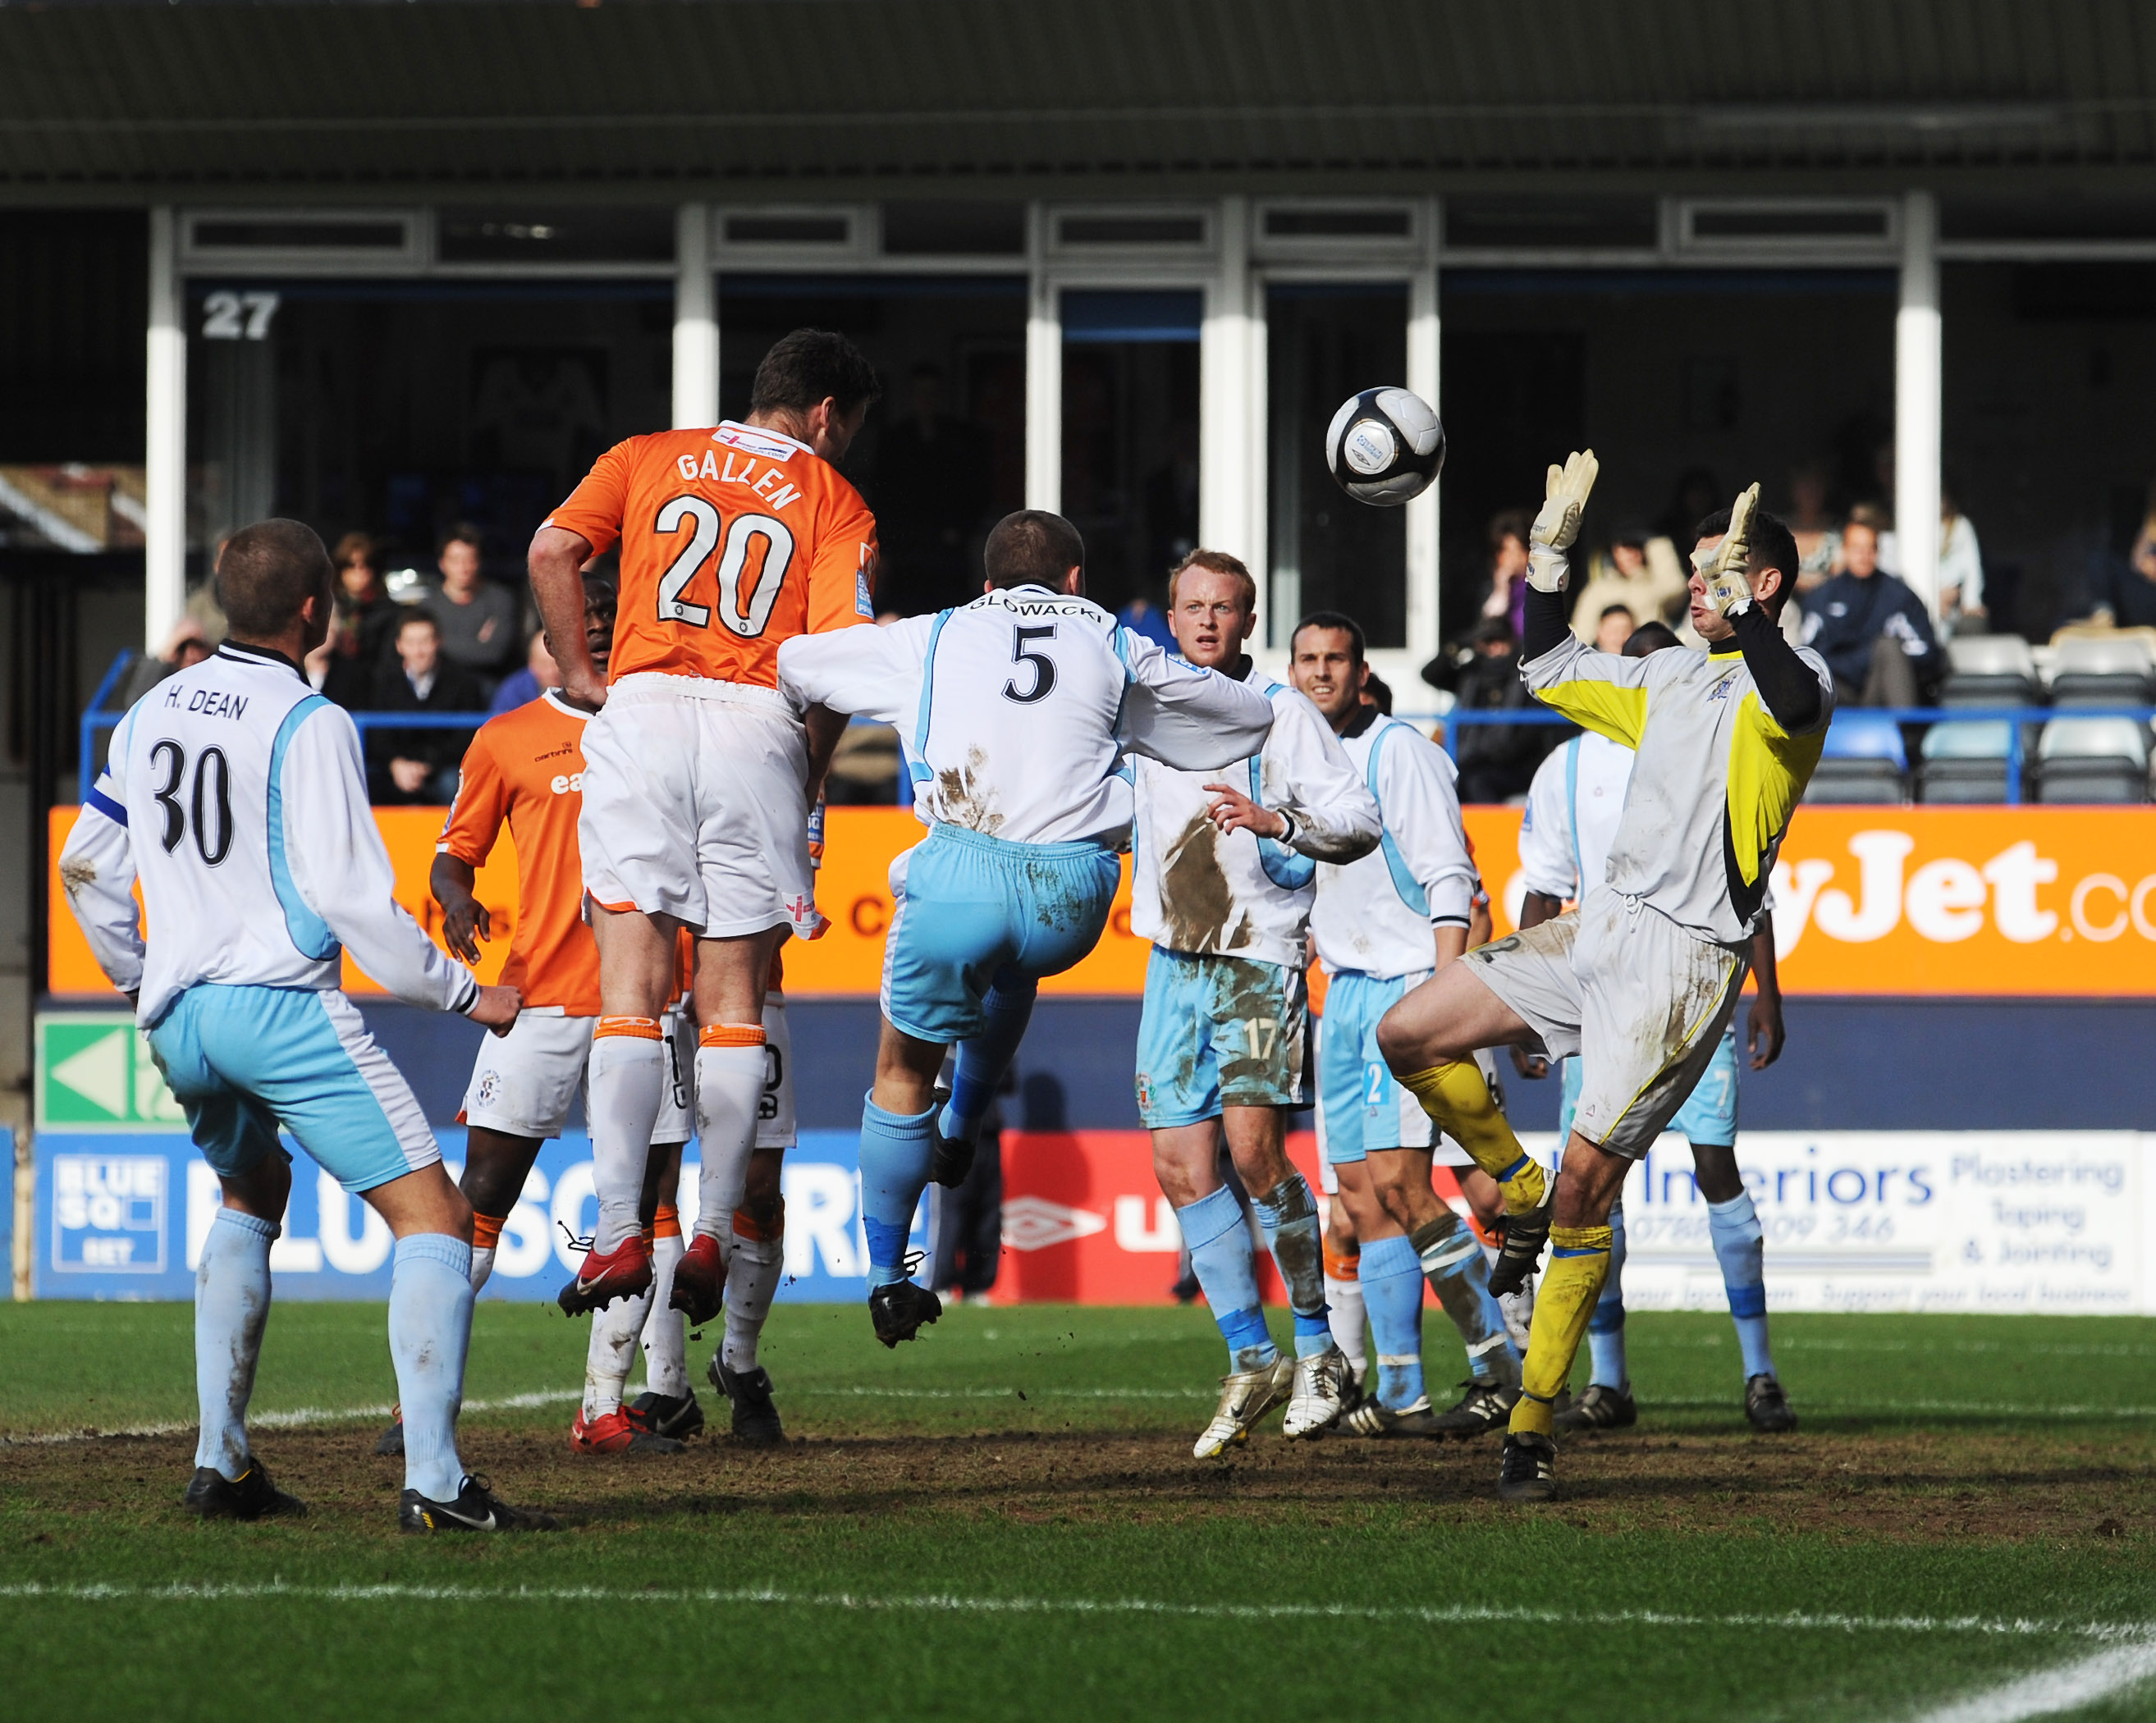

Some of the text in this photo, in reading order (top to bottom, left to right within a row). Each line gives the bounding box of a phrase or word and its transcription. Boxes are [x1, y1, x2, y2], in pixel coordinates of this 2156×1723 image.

[203, 290, 277, 339] 27
[677, 450, 802, 511] GALLEN
[654, 494, 795, 638] 20
[970, 596, 1101, 624] GLOWACKI
[1000, 622, 1059, 705] 5
[165, 684, 249, 720] H. DEAN
[149, 738, 235, 869] 30
[1243, 1017, 1279, 1060] 17
[1367, 1063, 1386, 1104] 2
[1713, 1069, 1731, 1107] 7
[58, 1159, 158, 1196] BLUE
[1644, 1144, 1933, 1205] Ineriors
[1952, 1153, 2124, 1194] Plastering
[58, 1195, 121, 1230] SQ
[1991, 1196, 2085, 1232] Taping
[83, 1236, 135, 1265] BET
